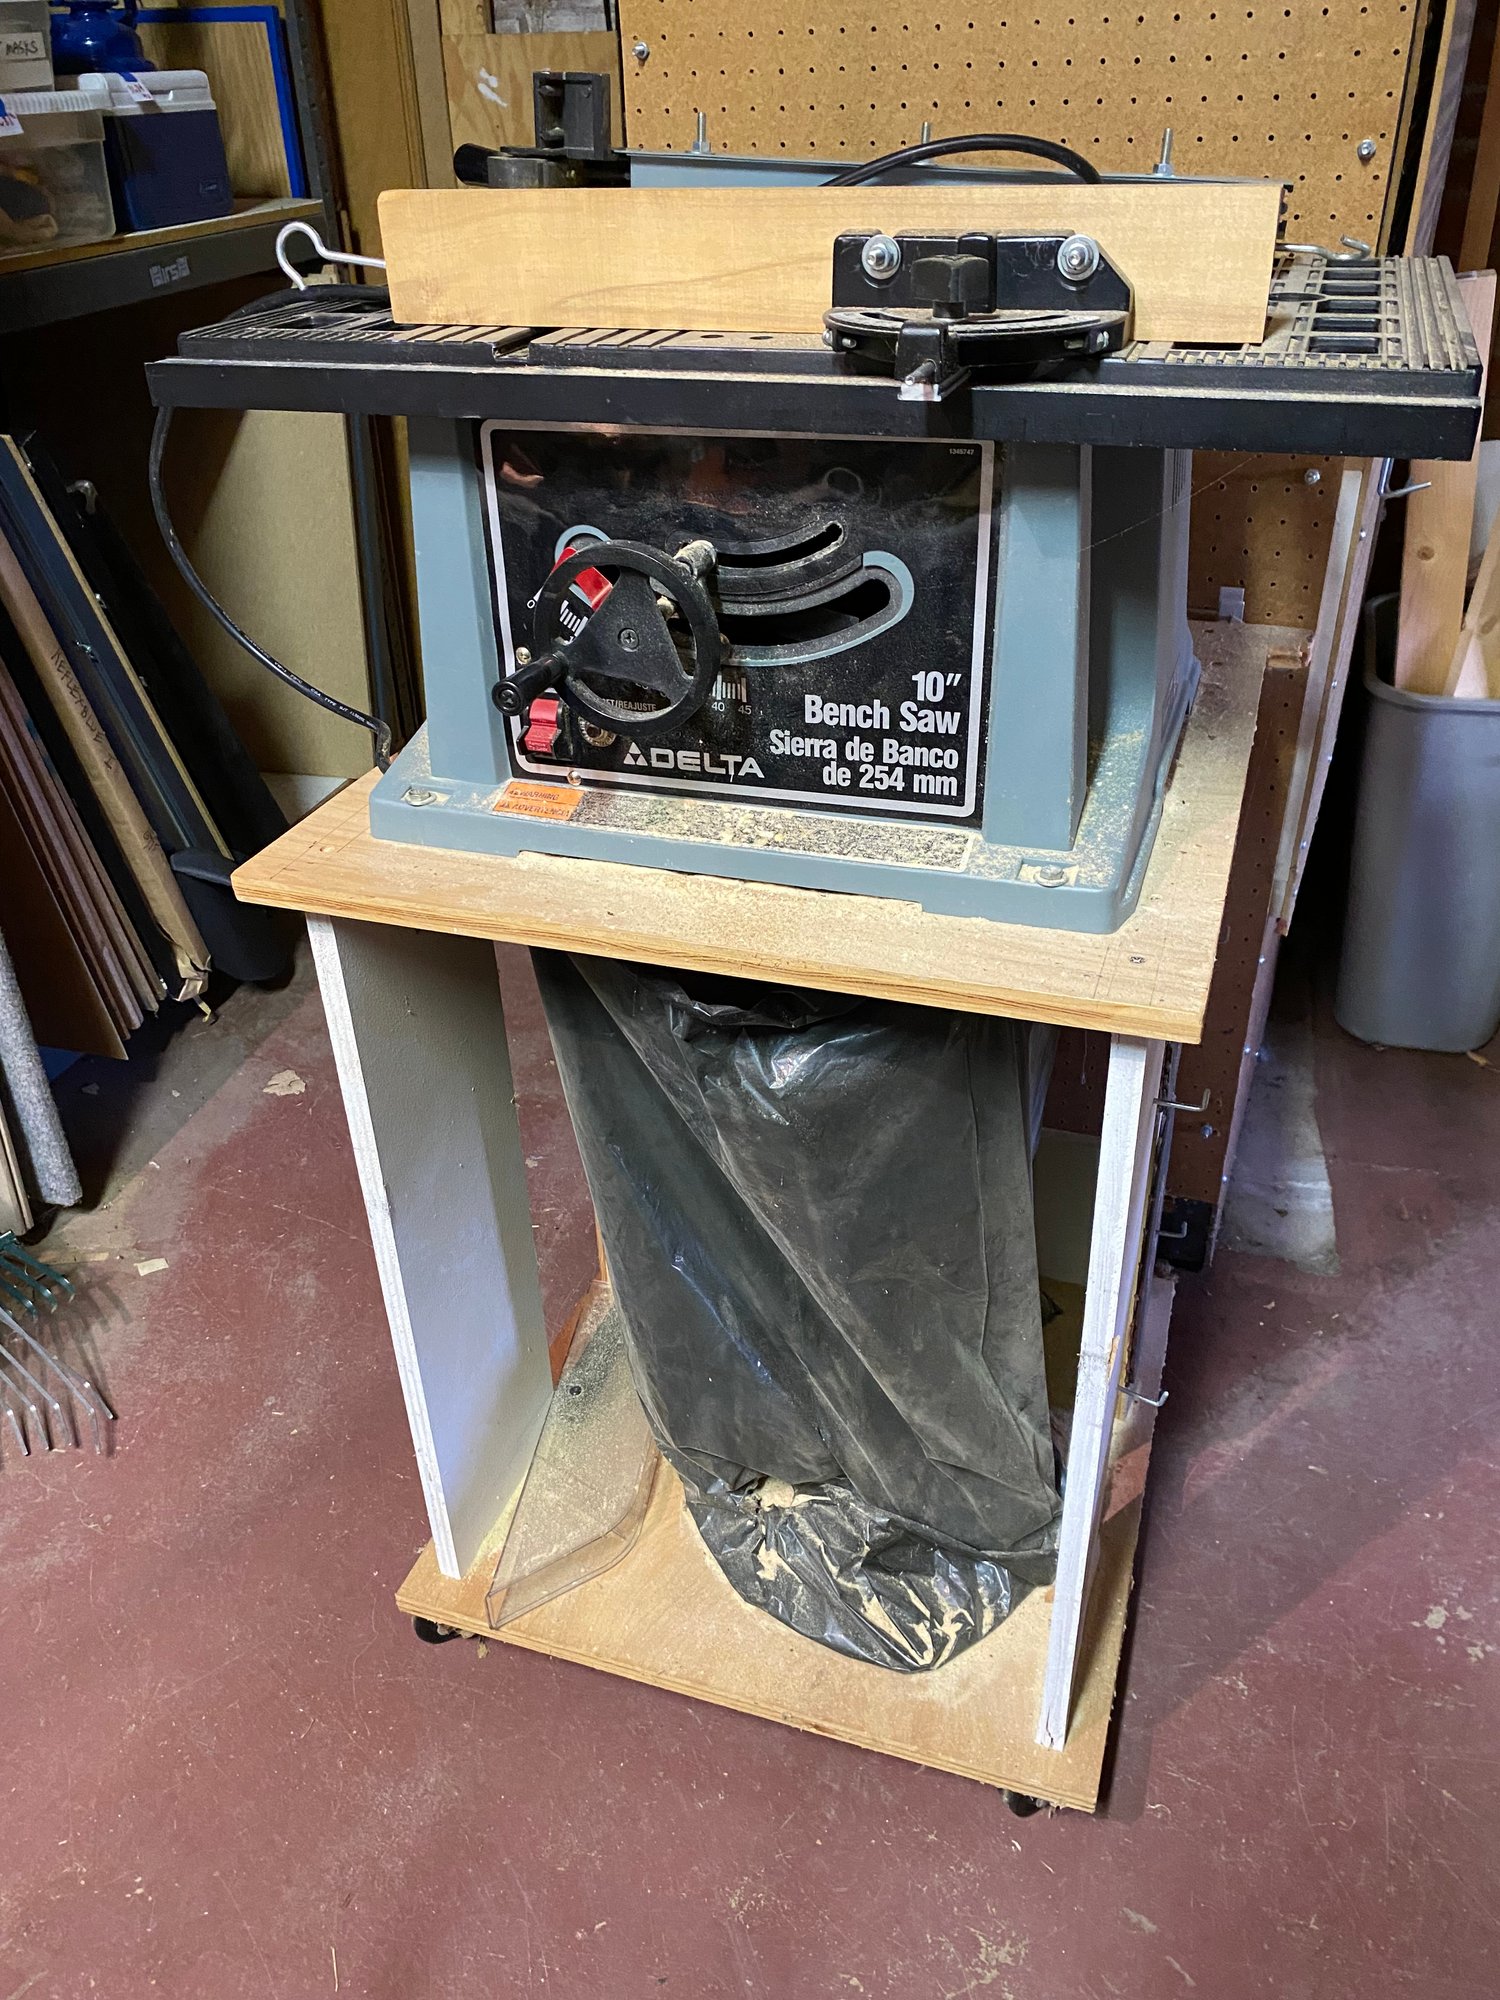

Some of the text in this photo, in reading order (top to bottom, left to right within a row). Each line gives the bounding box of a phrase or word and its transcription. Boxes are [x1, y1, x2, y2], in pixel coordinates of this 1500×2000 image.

[711, 701, 752, 715] 40 45
[804, 694, 961, 735] Bench Saw
[650, 747, 765, 779] DELTA
[769, 729, 959, 769] Sierra de Banco
[822, 761, 958, 797] de 254 mm
